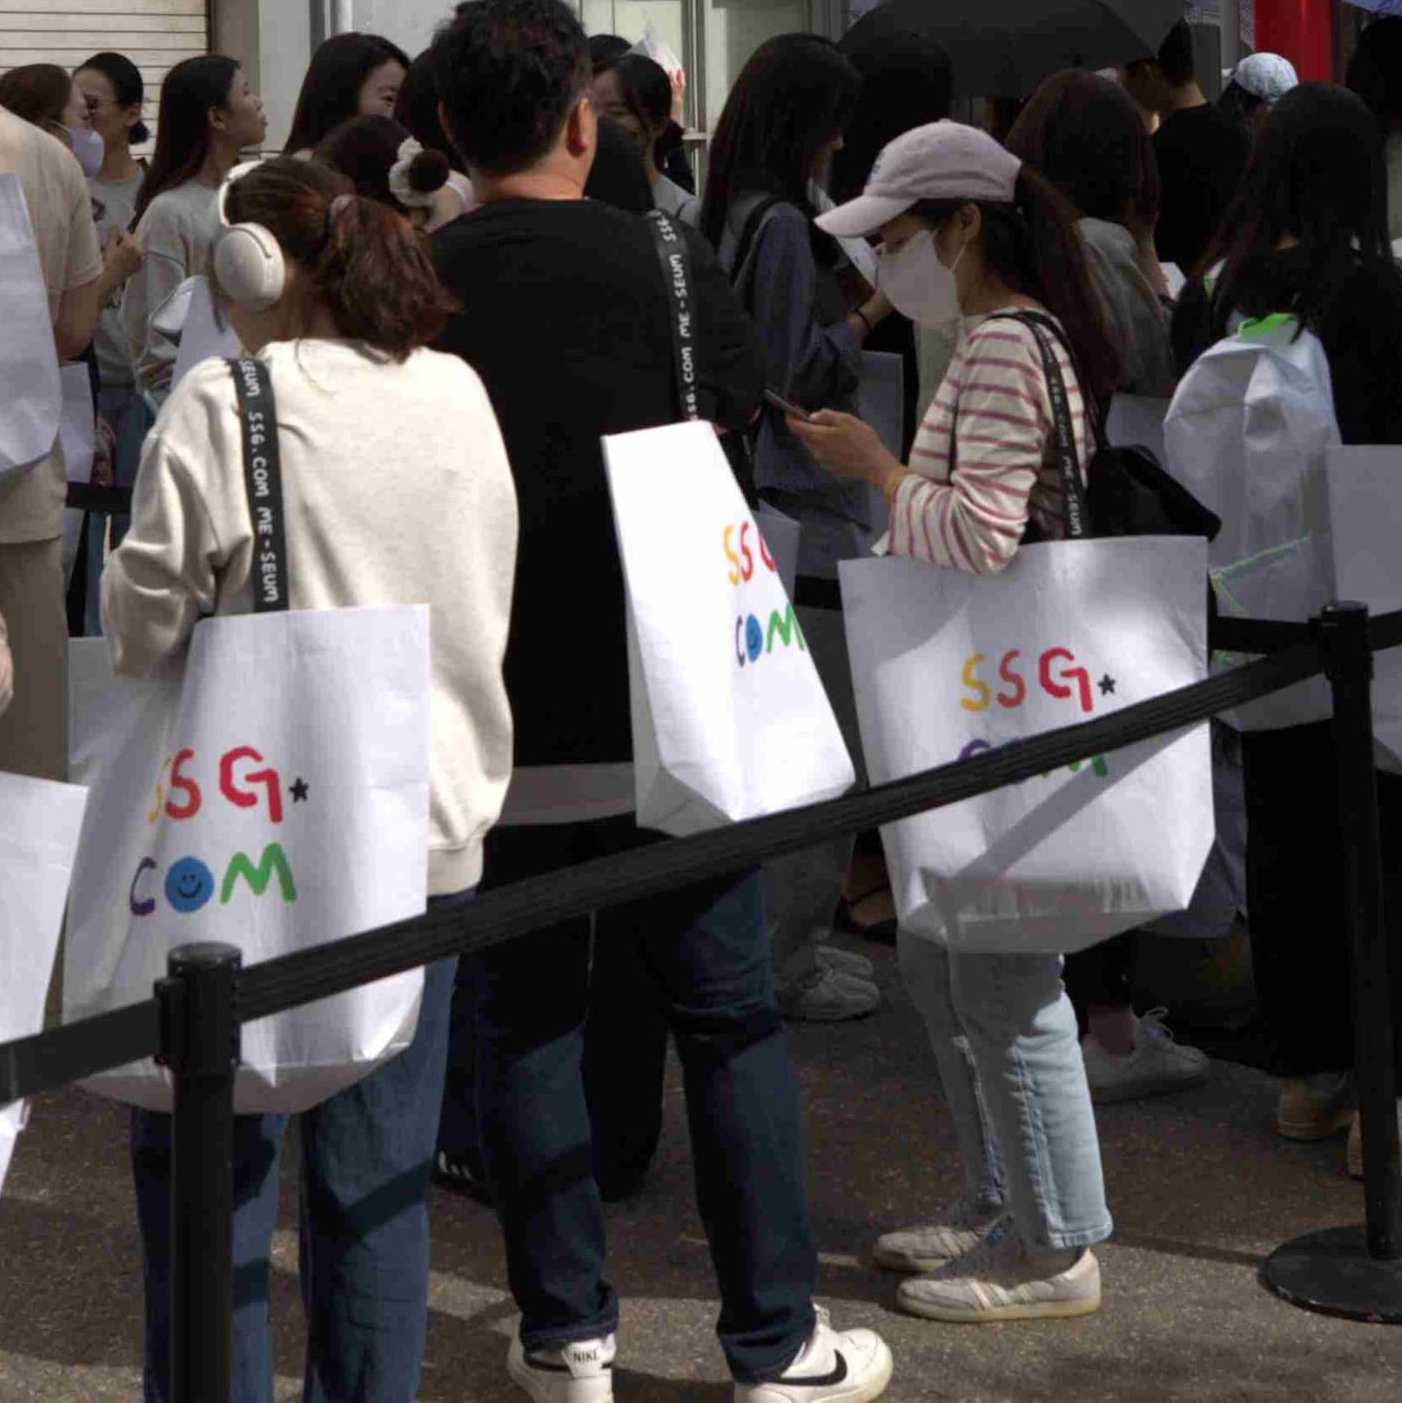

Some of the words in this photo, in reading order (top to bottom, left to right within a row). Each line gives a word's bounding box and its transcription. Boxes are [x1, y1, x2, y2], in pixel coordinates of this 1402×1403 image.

[249, 411, 270, 497] SSG.COM
[256, 506, 279, 602] ME-SEUM
[735, 602, 805, 668] COM
[960, 647, 1093, 713] SSG
[129, 841, 298, 916] COM
